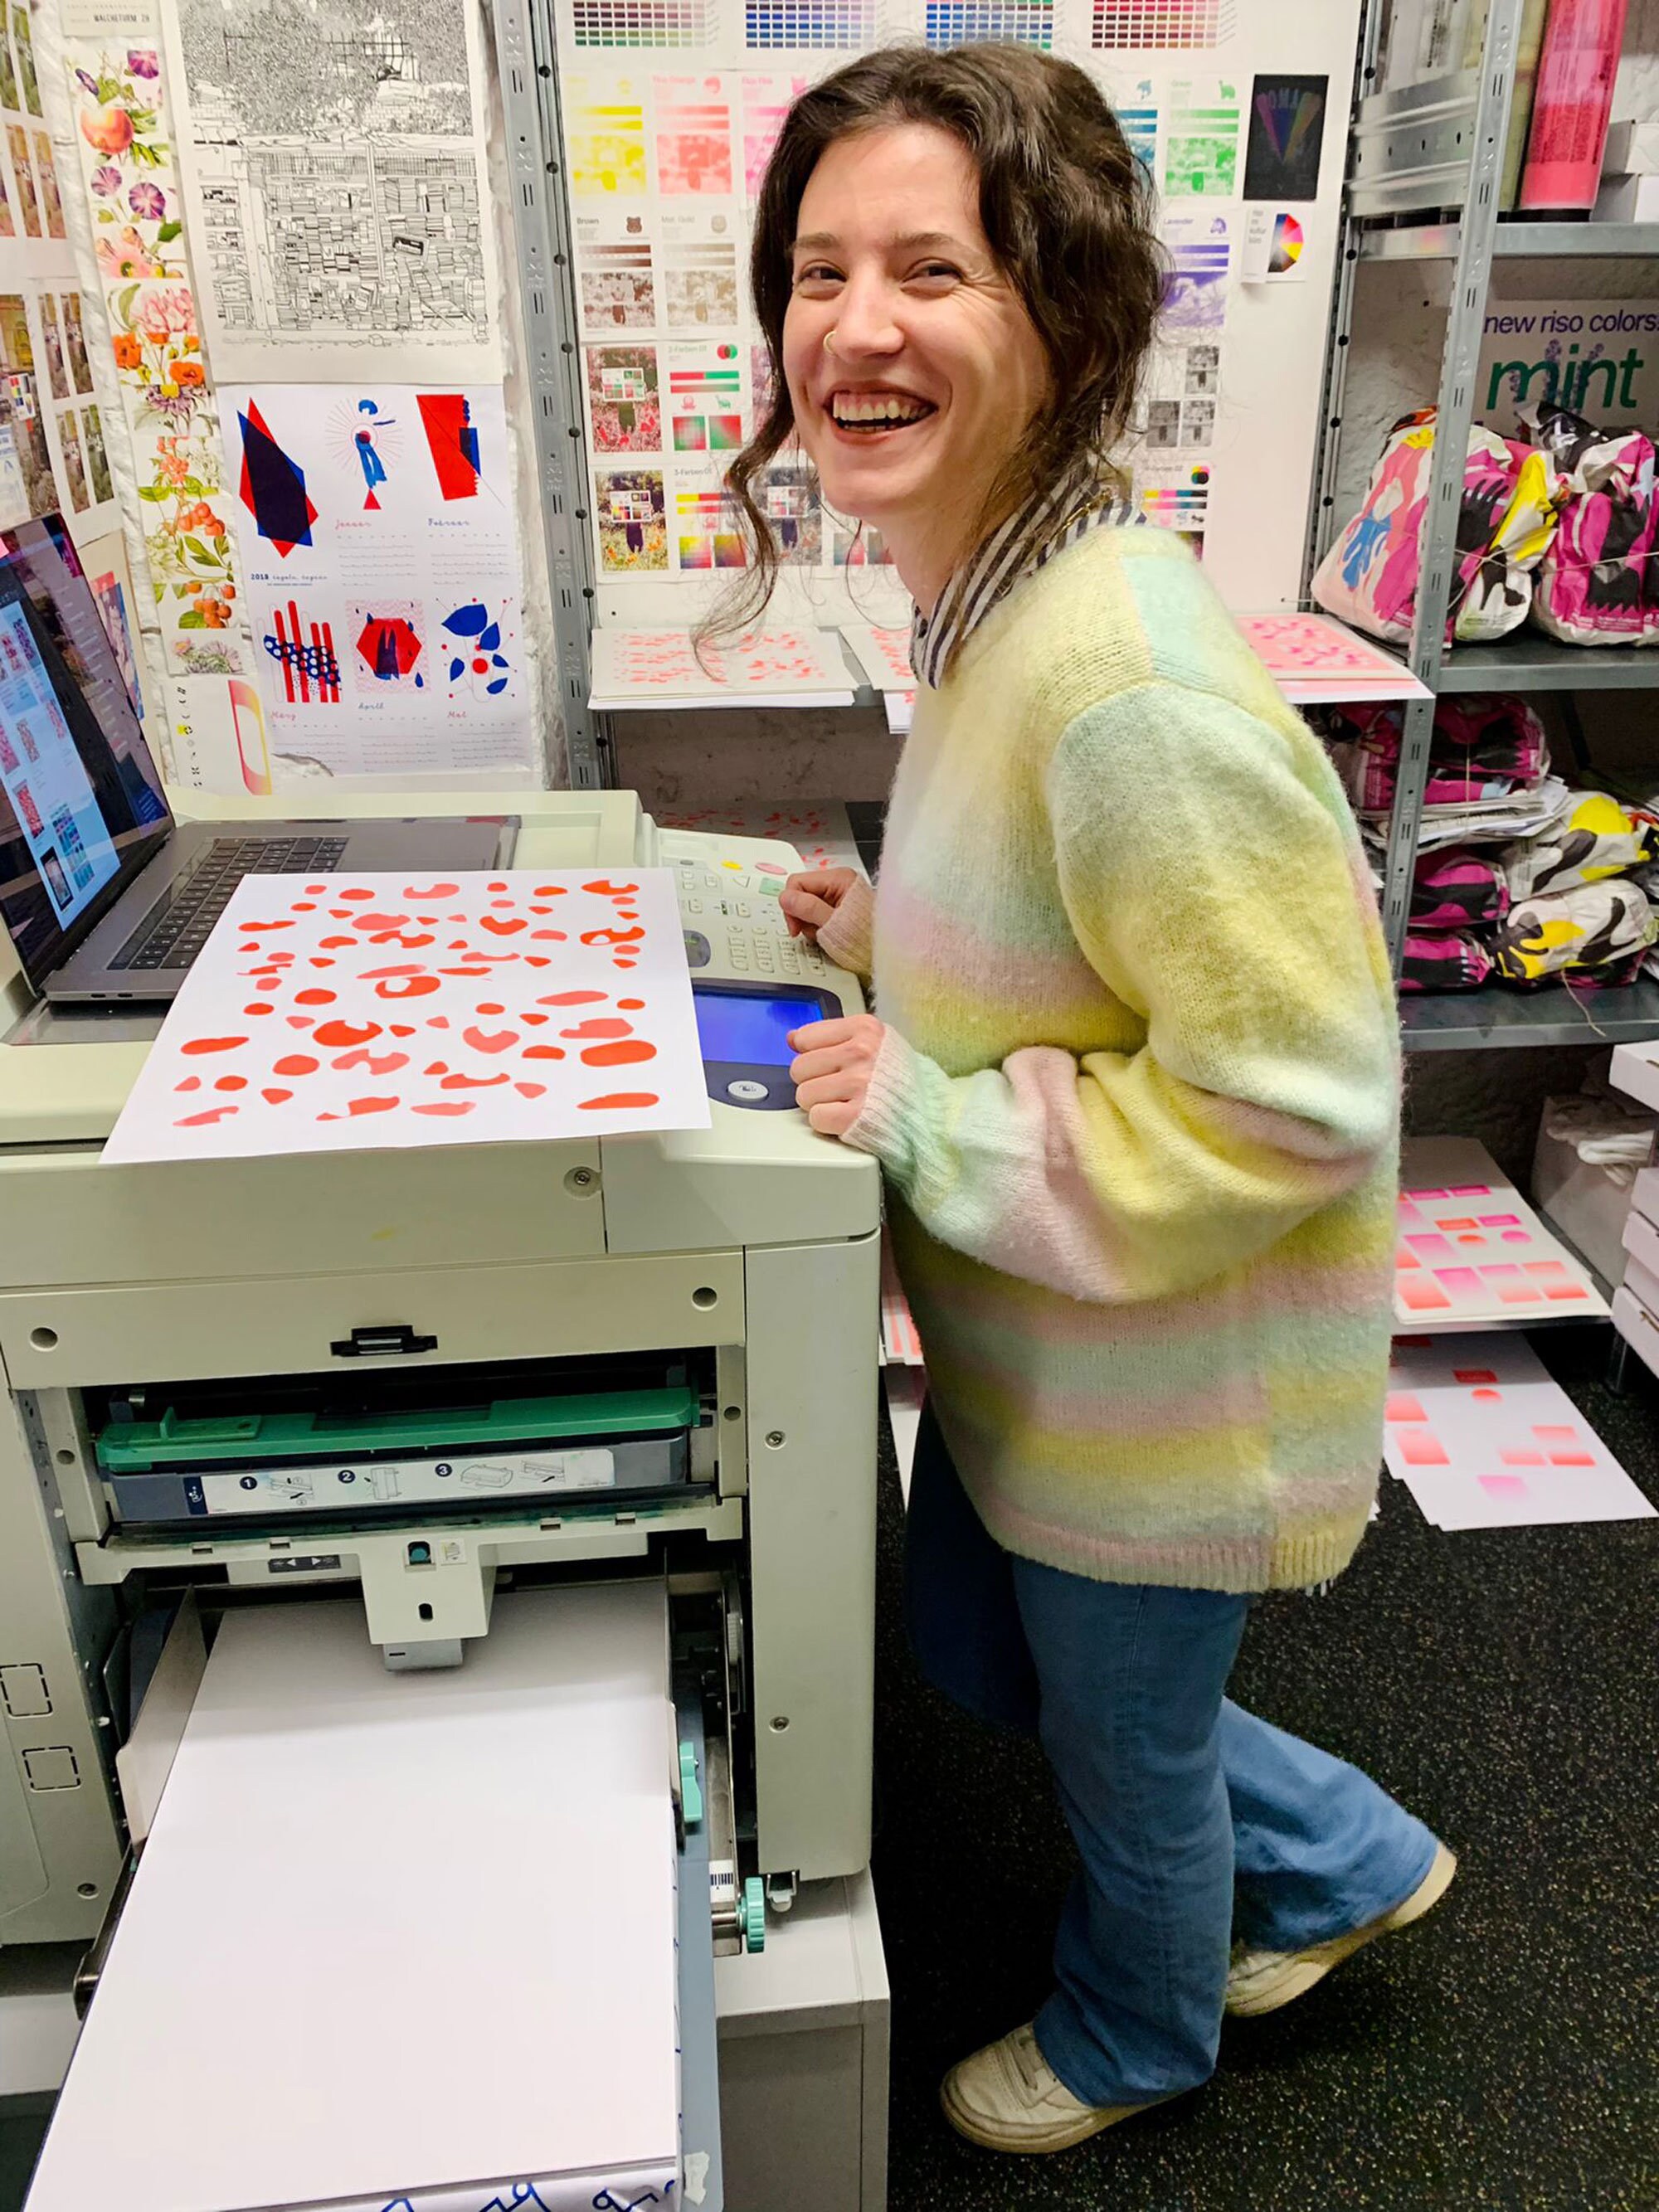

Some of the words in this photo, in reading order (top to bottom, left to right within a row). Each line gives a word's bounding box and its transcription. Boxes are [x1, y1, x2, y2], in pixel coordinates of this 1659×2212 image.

[577, 216, 599, 225] Brown
[1484, 315, 1536, 333] new
[1540, 309, 1584, 333] riso
[1486, 343, 1644, 411] mint
